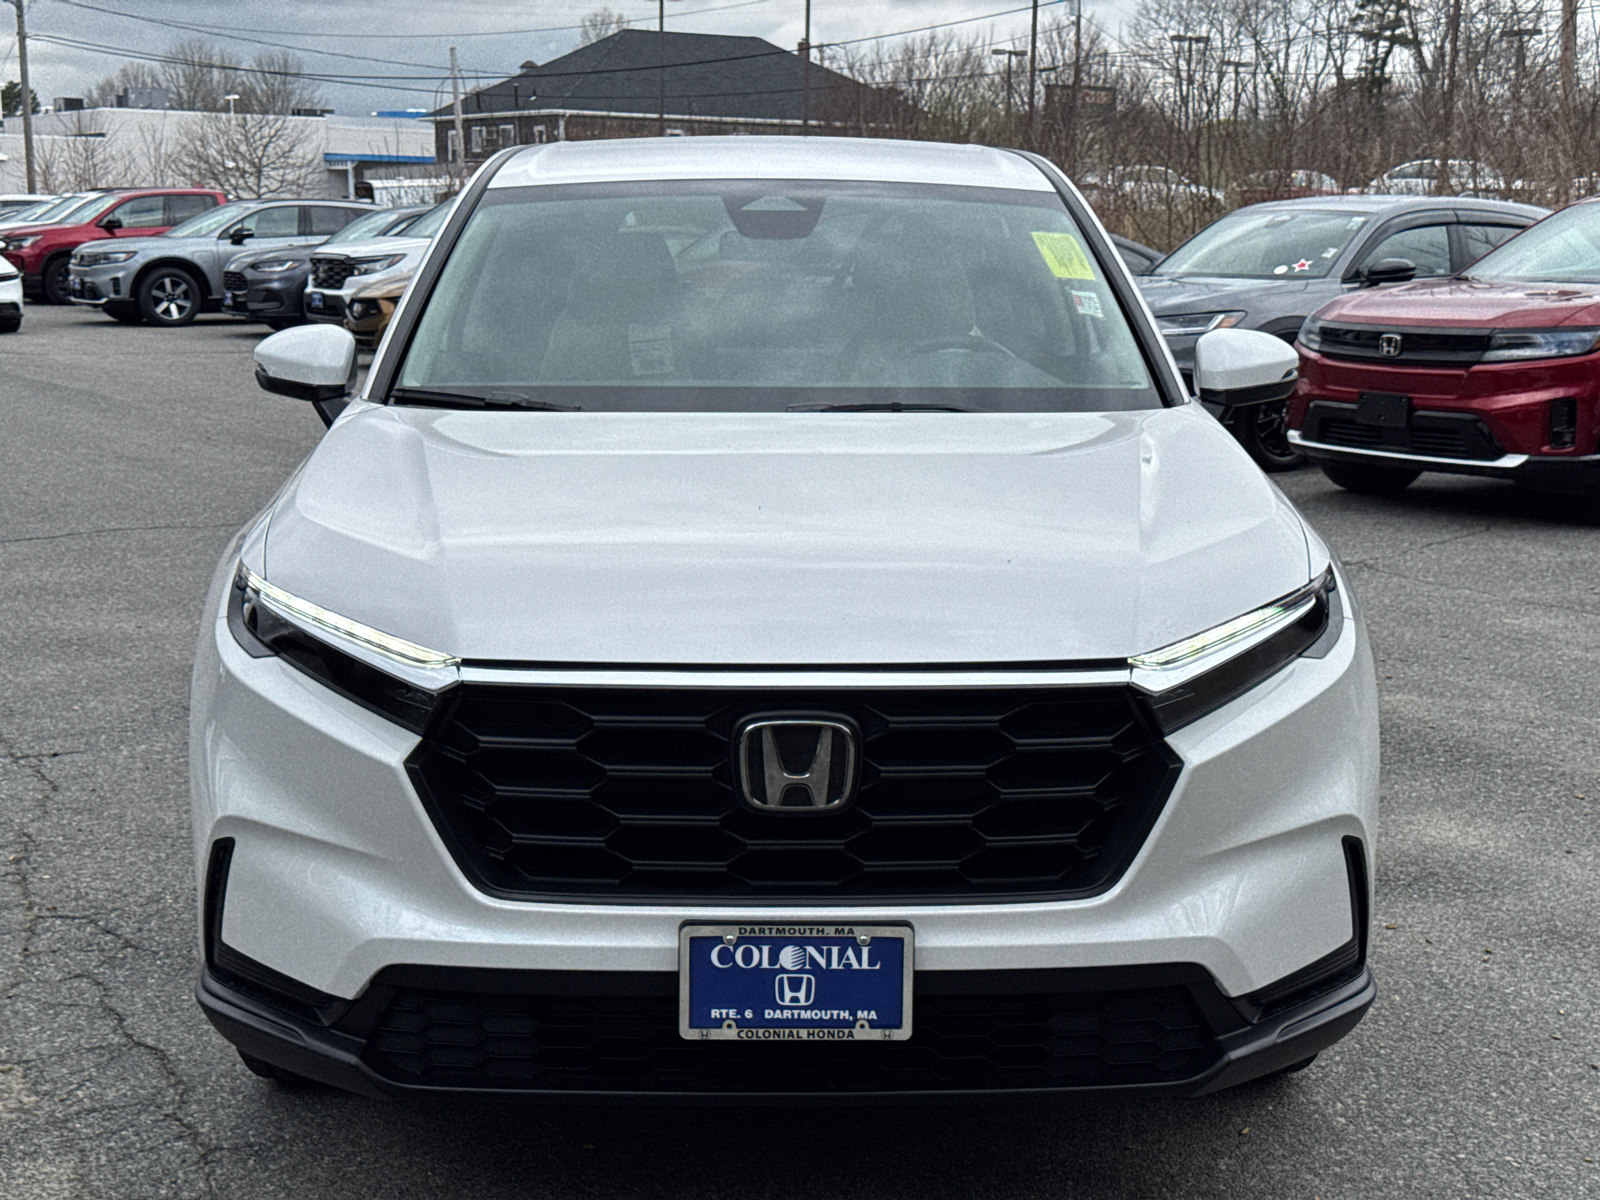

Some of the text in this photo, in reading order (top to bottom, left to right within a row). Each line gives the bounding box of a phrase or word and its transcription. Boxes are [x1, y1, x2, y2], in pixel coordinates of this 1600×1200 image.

[738, 926, 855, 936] DARTMOUTH, MA
[710, 944, 881, 970] COLONIAL
[710, 1009, 878, 1021] RTE. 6 DARTMOUTH, MA
[737, 1029, 855, 1039] COLONIAL HONDA
